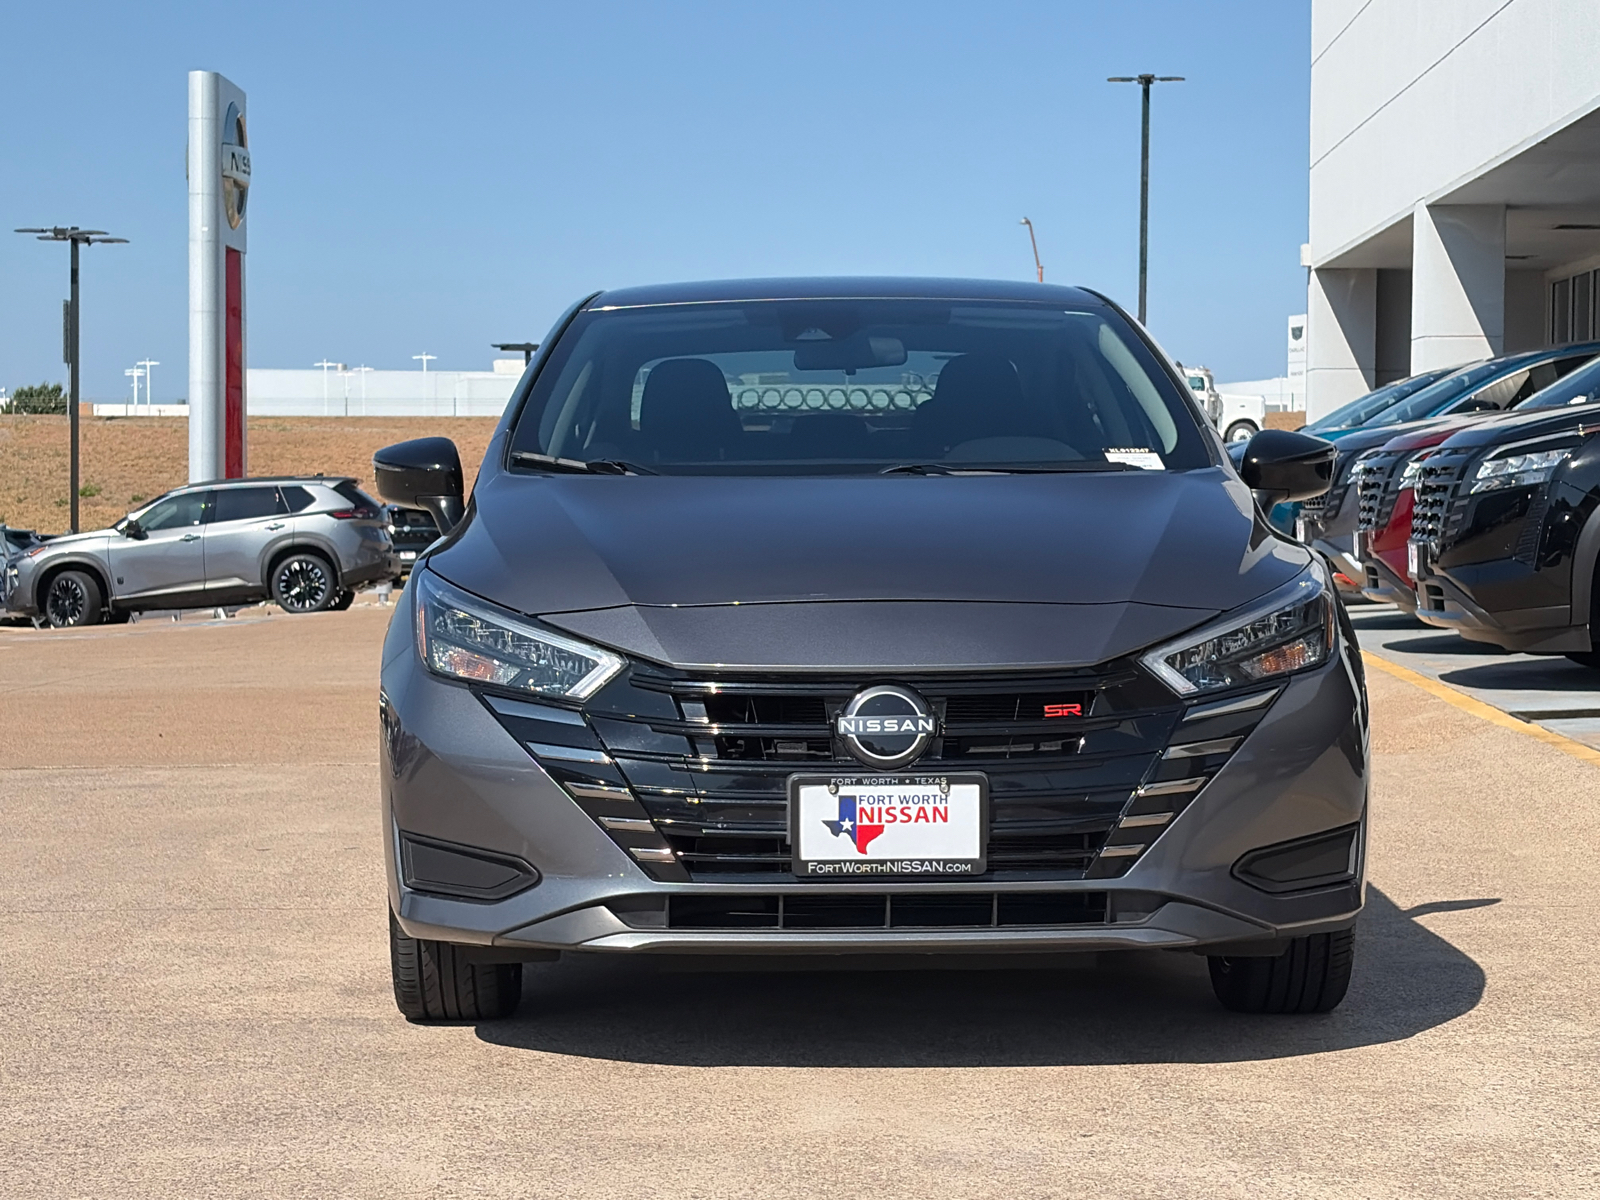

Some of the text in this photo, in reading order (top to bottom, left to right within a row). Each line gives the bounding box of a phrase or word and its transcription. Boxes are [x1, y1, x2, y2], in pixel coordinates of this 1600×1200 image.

[1044, 703, 1082, 717] SR
[839, 718, 933, 733] NISSAN
[830, 777, 948, 785] FORT WORTH TEXAS
[858, 794, 949, 805] FORT WORTH
[858, 806, 949, 824] NISSAN
